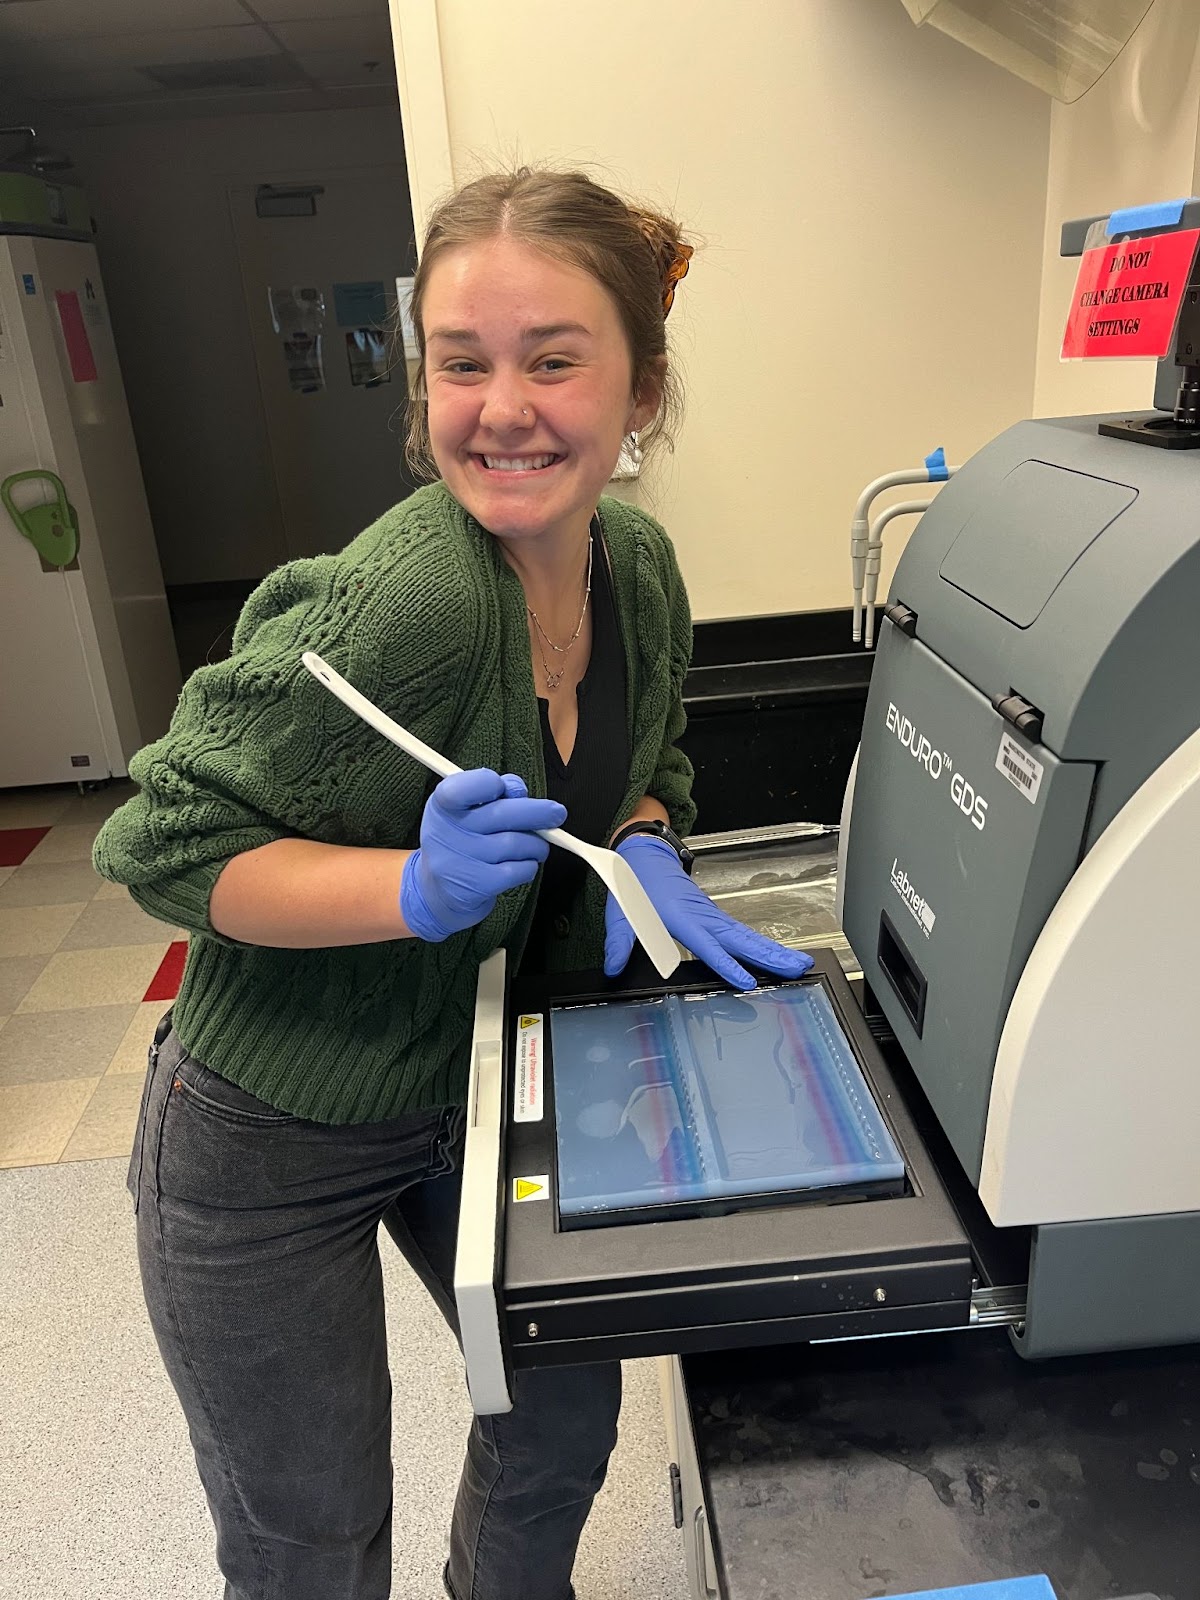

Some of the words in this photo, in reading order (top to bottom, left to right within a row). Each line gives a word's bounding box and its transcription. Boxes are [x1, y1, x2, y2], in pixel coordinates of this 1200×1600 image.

[1109, 256, 1126, 273] DO
[1125, 251, 1151, 270] NOT
[1080, 287, 1121, 307] CHANGE
[1121, 282, 1169, 302] CAMERA
[1088, 318, 1140, 337] SETTINGS
[950, 772, 988, 830] GDS
[891, 858, 925, 917] Labnet
[528, 1037, 537, 1057] Warning!
